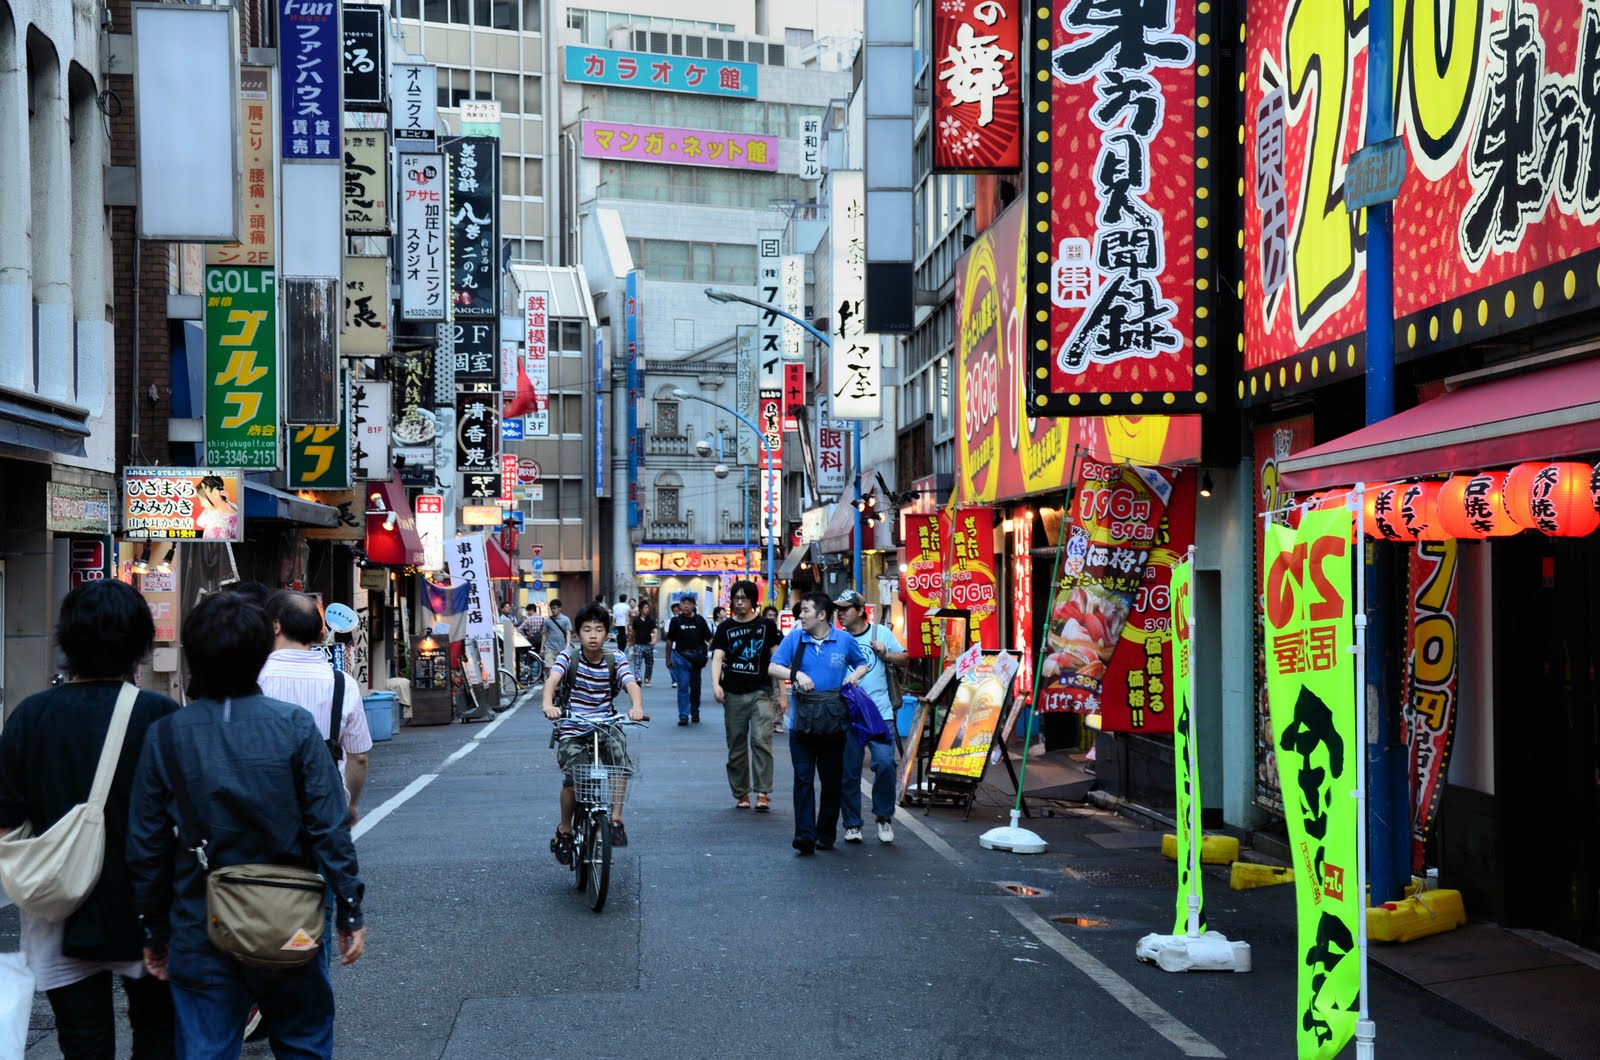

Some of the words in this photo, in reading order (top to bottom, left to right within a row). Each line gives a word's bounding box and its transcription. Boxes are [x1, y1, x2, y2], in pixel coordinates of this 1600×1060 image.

[284, 0, 333, 15] Fun
[296, 25, 323, 116] ファンハウス
[584, 55, 741, 90] カラオケ館
[939, 0, 1013, 127] の舞
[407, 67, 421, 128] オムニクス
[594, 129, 767, 164] マンガ・ネット館
[804, 120, 818, 176] 新和ビル
[248, 105, 265, 245] 肩こり・腰痛・頭痛
[406, 190, 440, 201] アサヒ
[247, 252, 269, 263] 2F
[407, 229, 420, 280] スタジオ
[425, 204, 440, 306] 加圧トレーニング
[461, 246, 478, 289] 二の丸
[207, 269, 274, 293] GOLF
[207, 297, 233, 307] 新宿
[453, 325, 490, 344] 2F
[528, 296, 545, 361] 鉄道模型
[214, 310, 268, 428] ゴルフ
[738, 336, 750, 456] 隠れ家的個室ダニング
[247, 425, 275, 437] 商会
[367, 426, 382, 434] B1F
[464, 402, 487, 467] 清香苑
[529, 421, 545, 431] 3F
[207, 441, 275, 449] shinjukugolf.com
[208, 450, 275, 465] 03-3346-2151
[820, 428, 842, 473] 眼科
[471, 476, 495, 485] 2F
[1082, 462, 1122, 481] 296円
[1145, 473, 1170, 496] 全品
[128, 480, 195, 496] ひざまくら
[1531, 466, 1559, 534] 炙り焼き
[130, 499, 192, 515] みみかき
[1081, 488, 1150, 521] 196円
[128, 518, 193, 529] 山本耳かき店
[964, 516, 979, 559] ぜったい
[1111, 522, 1154, 540] 396円
[1087, 545, 1149, 573] 価格!
[907, 574, 941, 590] 396
[1060, 573, 1140, 592] ぜたい満足!!
[1145, 637, 1165, 713] 価値ある
[1128, 670, 1145, 728] 価格!!
